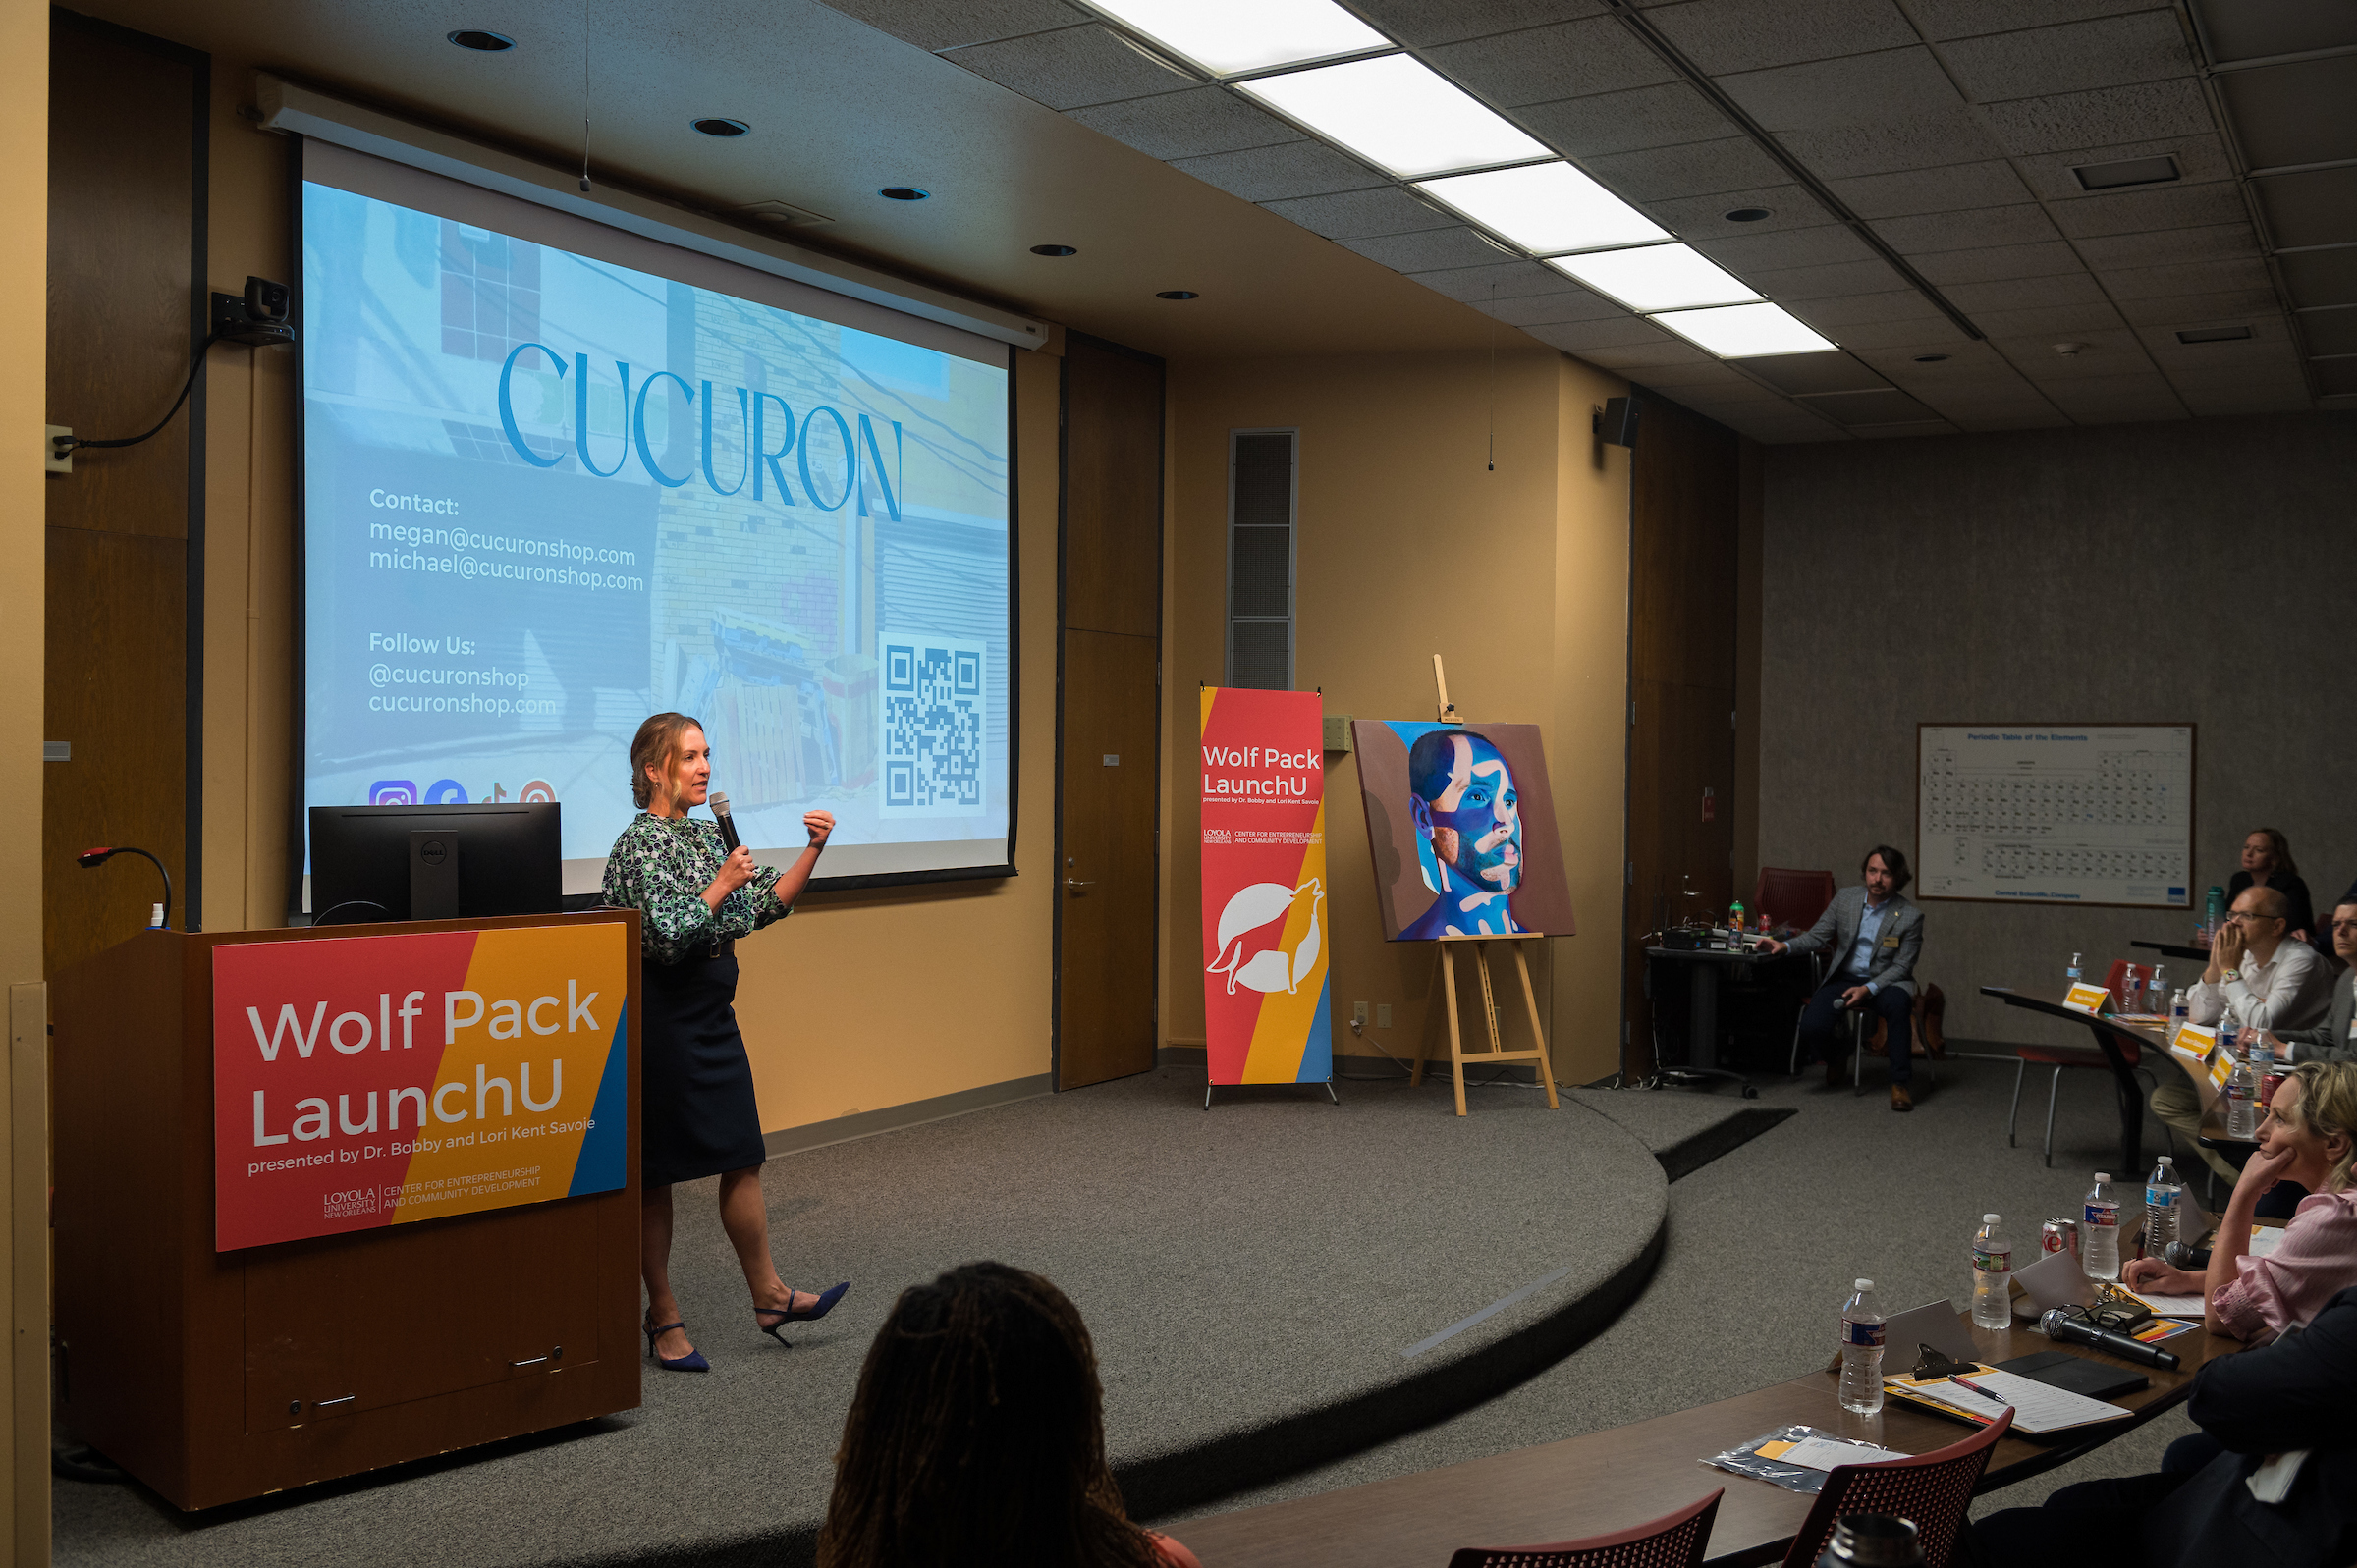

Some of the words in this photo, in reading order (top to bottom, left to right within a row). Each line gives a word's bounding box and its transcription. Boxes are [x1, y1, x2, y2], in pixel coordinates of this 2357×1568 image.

[498, 343, 903, 522] CUCURON
[369, 488, 460, 517] Contact:
[369, 521, 636, 567] megan@cucuronshop.com
[369, 547, 643, 592] michael@cucuronshop.com
[369, 633, 440, 656] Follow
[447, 636, 476, 657] Us:
[369, 663, 529, 691] @cucuronshop
[369, 693, 556, 718] cucuronshop.com
[1203, 746, 1259, 768] Wolf
[1265, 749, 1320, 770] Pack
[1204, 774, 1307, 796] LaunchU
[246, 990, 426, 1062] Wolf
[444, 979, 600, 1045] Pack
[253, 1059, 562, 1148] LaunchU
[247, 1150, 335, 1177] presented
[340, 1147, 360, 1164] by
[363, 1145, 387, 1160] Dr.
[391, 1137, 442, 1158] Bobby
[446, 1133, 475, 1149] and
[479, 1128, 508, 1145] Lori
[511, 1124, 546, 1140] Kent
[550, 1118, 596, 1134] Savoie
[383, 1182, 422, 1197] CENTER
[425, 1179, 445, 1191] FOR
[447, 1165, 541, 1188] ENTREPRENEURSHIP
[383, 1196, 407, 1209] AND
[408, 1187, 469, 1206] COMMUNITY
[471, 1177, 541, 1196] DEVELOPMENT
[324, 1188, 376, 1206] LOYOLA
[324, 1199, 376, 1214] UNIVERSITY
[324, 1210, 342, 1219] NEW
[341, 1206, 376, 1218] ORLEANS
